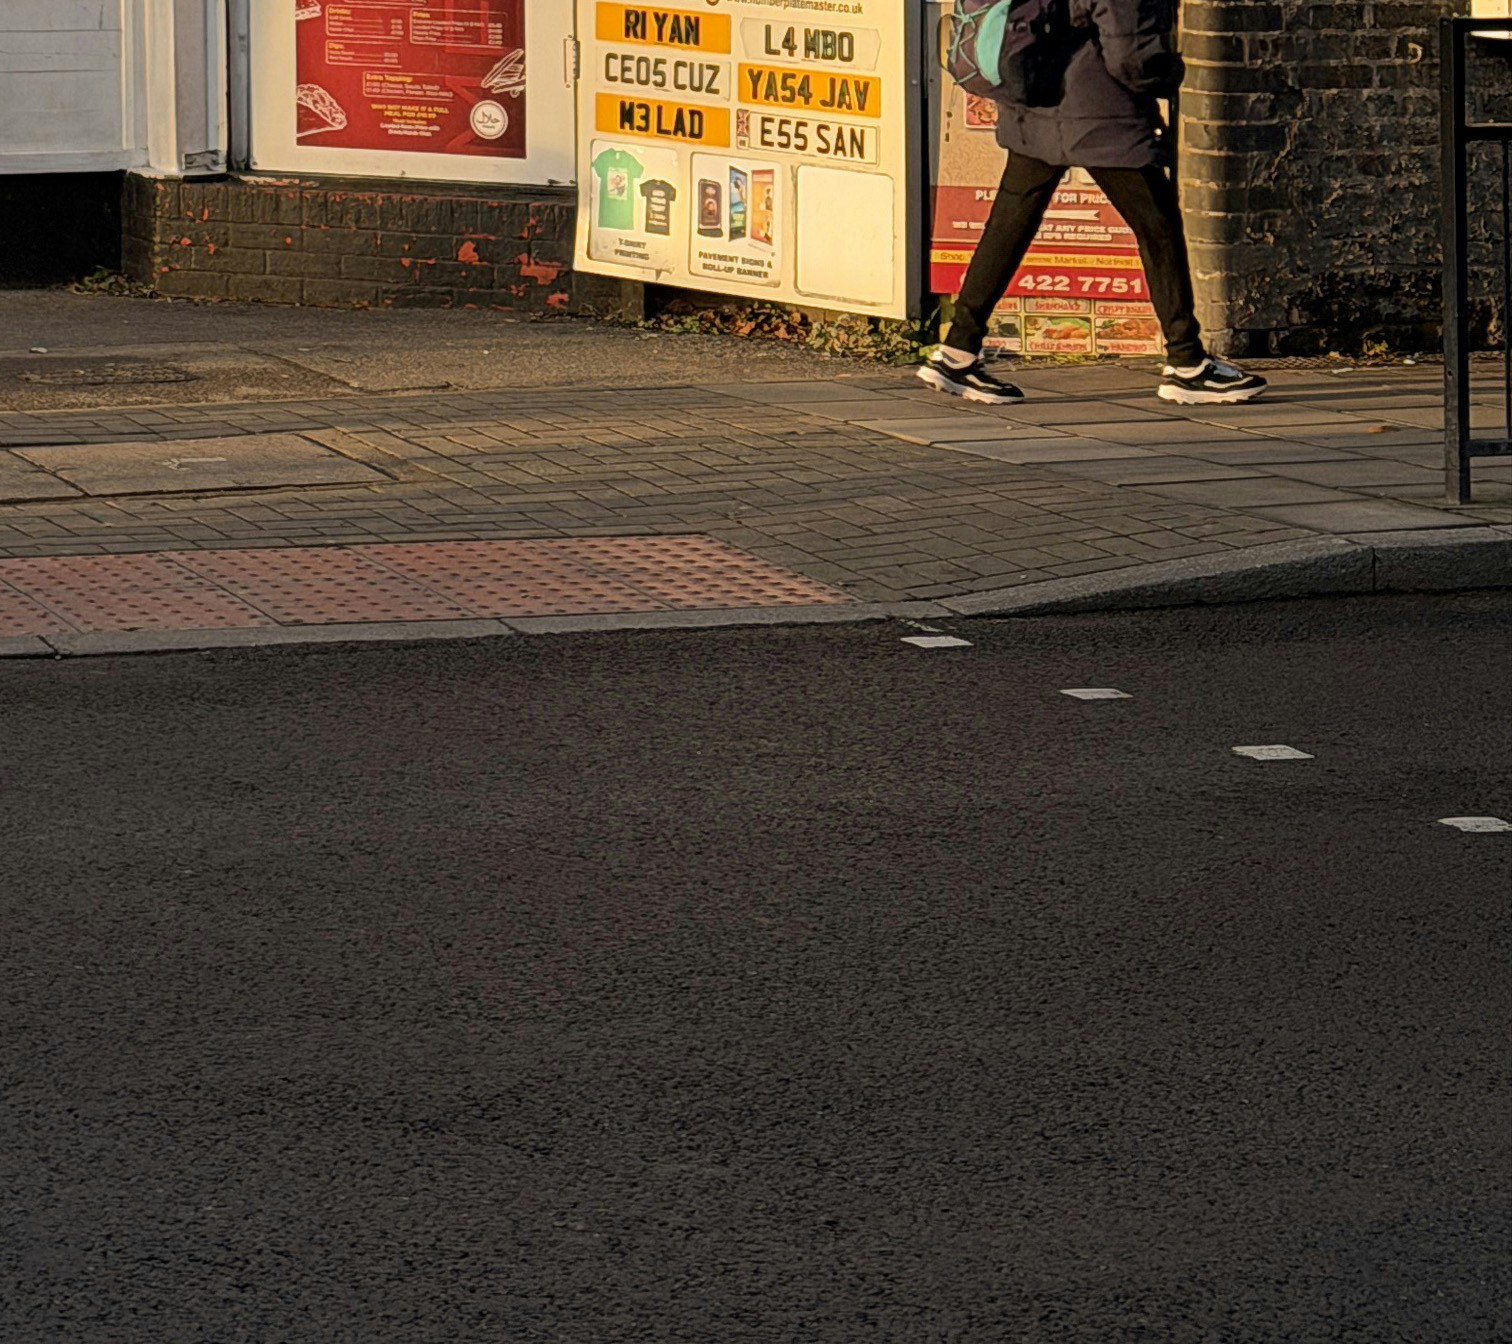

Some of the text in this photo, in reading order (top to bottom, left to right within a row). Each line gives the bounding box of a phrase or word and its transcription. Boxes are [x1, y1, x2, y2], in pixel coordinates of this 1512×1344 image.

[652, 12, 700, 46] YAN
[764, 23, 797, 57] L4
[673, 60, 720, 95] CUZ
[619, 99, 704, 139] M3 LAD
[816, 123, 866, 159] SAN
[698, 251, 739, 263] PAVEMENT
[702, 262, 769, 279] ROLL-UP BANNER
[1018, 274, 1142, 293] 422 7751
